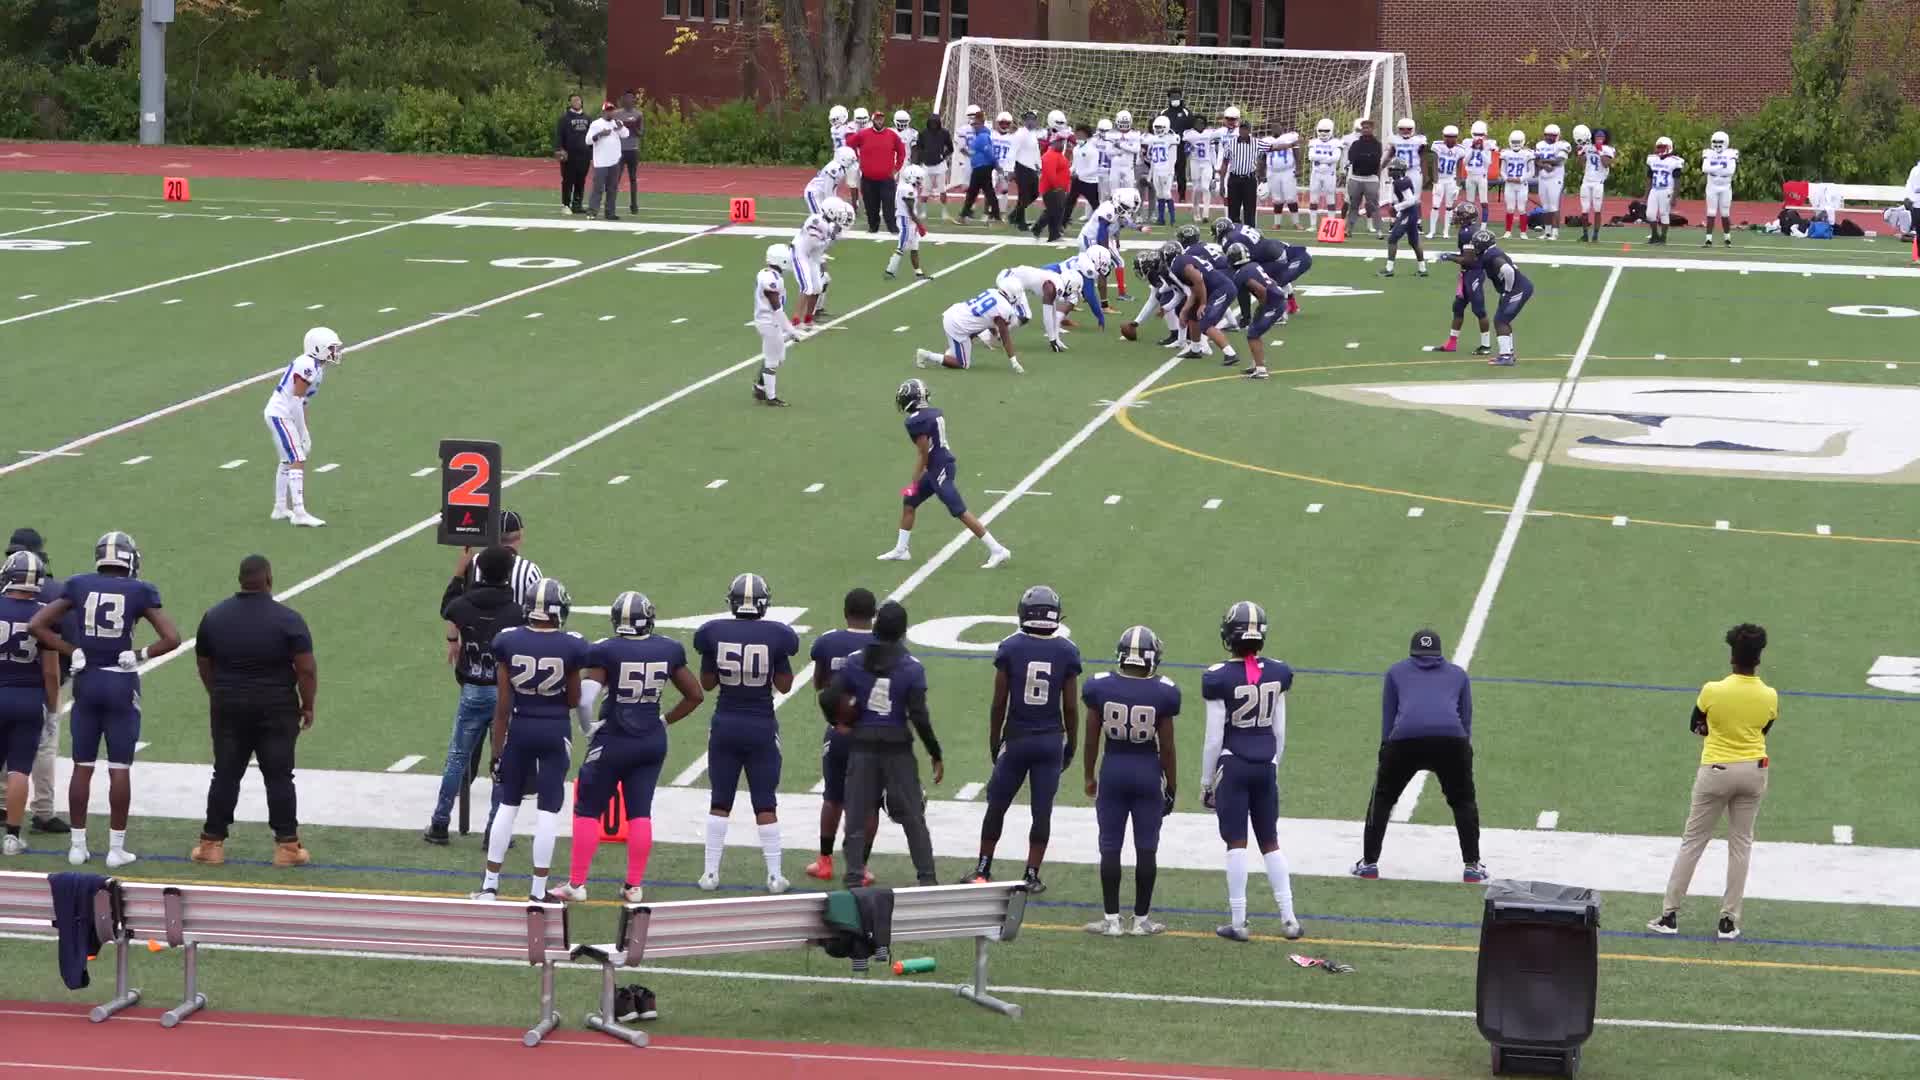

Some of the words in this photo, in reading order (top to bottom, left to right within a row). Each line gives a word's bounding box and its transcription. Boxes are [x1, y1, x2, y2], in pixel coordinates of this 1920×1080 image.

[1152, 146, 1168, 164] 33
[1438, 156, 1456, 175] 30
[1507, 162, 1525, 177] 28
[167, 181, 183, 200] 20
[734, 200, 750, 219] 30
[1322, 219, 1338, 238] 40
[447, 451, 490, 507] 2
[83, 591, 126, 638] 13
[510, 654, 564, 697] 22
[615, 661, 668, 704] 55
[716, 641, 770, 687] 50
[1023, 661, 1052, 706] 6
[866, 677, 893, 716] 4
[1231, 680, 1282, 729] 20
[1102, 700, 1157, 744] 88
